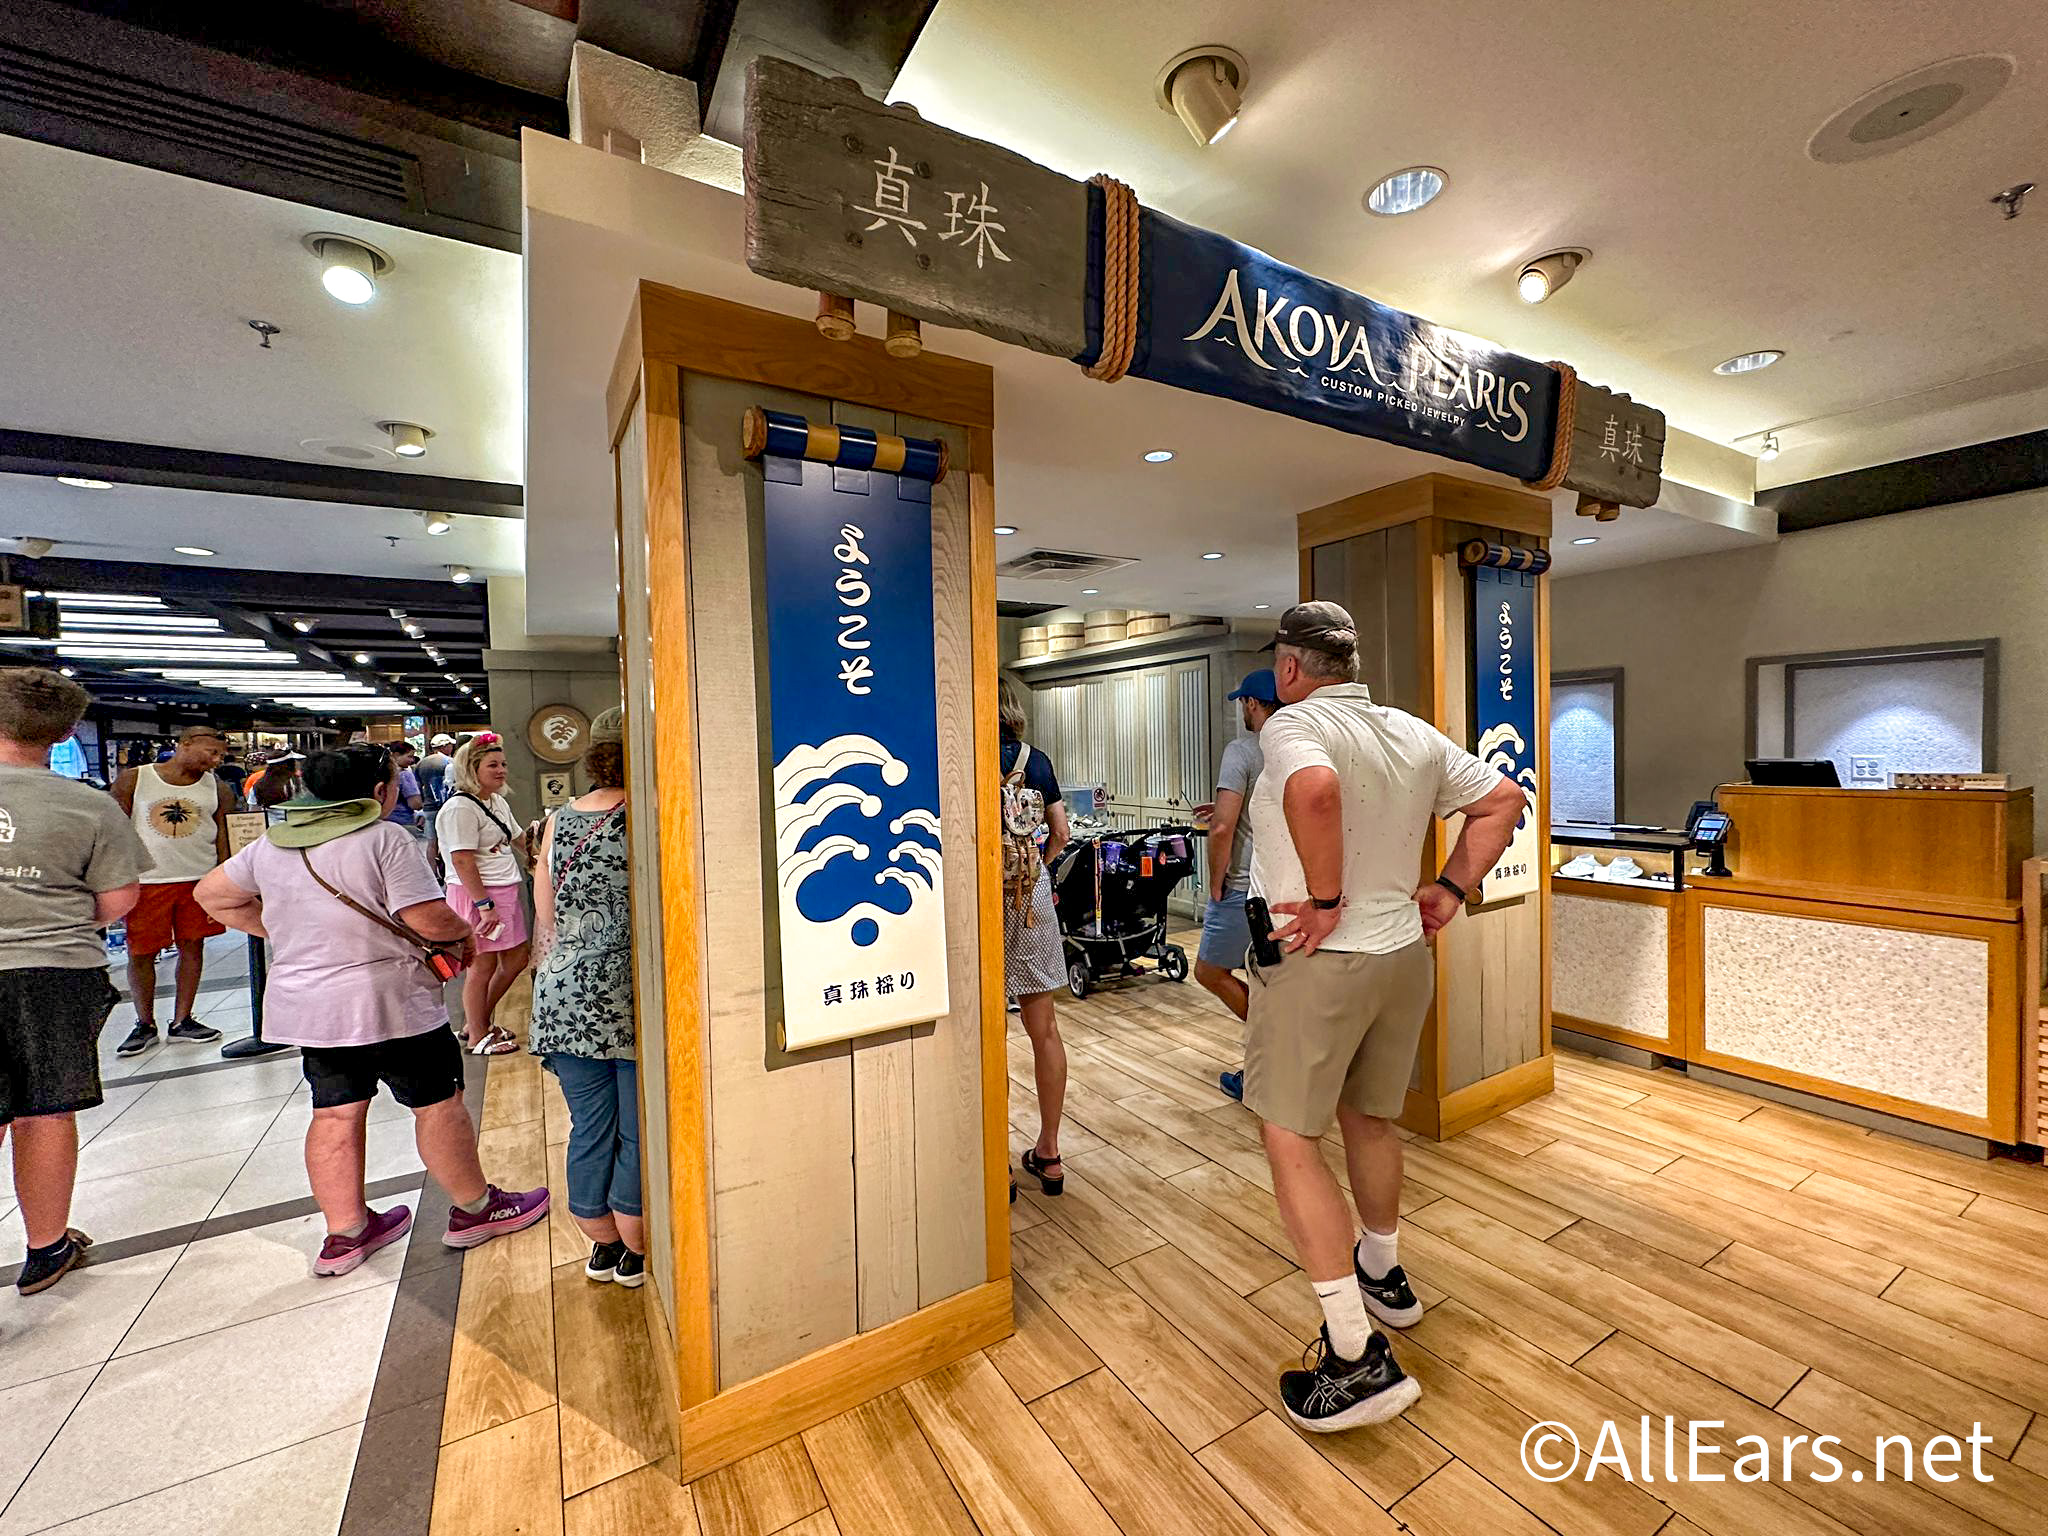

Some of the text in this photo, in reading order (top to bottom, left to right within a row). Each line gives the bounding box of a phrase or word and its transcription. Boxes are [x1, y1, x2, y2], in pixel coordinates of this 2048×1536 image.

[852, 146, 1013, 269] 真珠
[1184, 268, 1530, 442] AKOYA PEARLS
[1320, 375, 1466, 427] CUSTOM PICKED JEWELRY
[1598, 413, 1644, 465] 真珠
[833, 523, 875, 696] ようこそ
[1499, 601, 1513, 701] ようこそ
[823, 971, 915, 1006] 真珠採り
